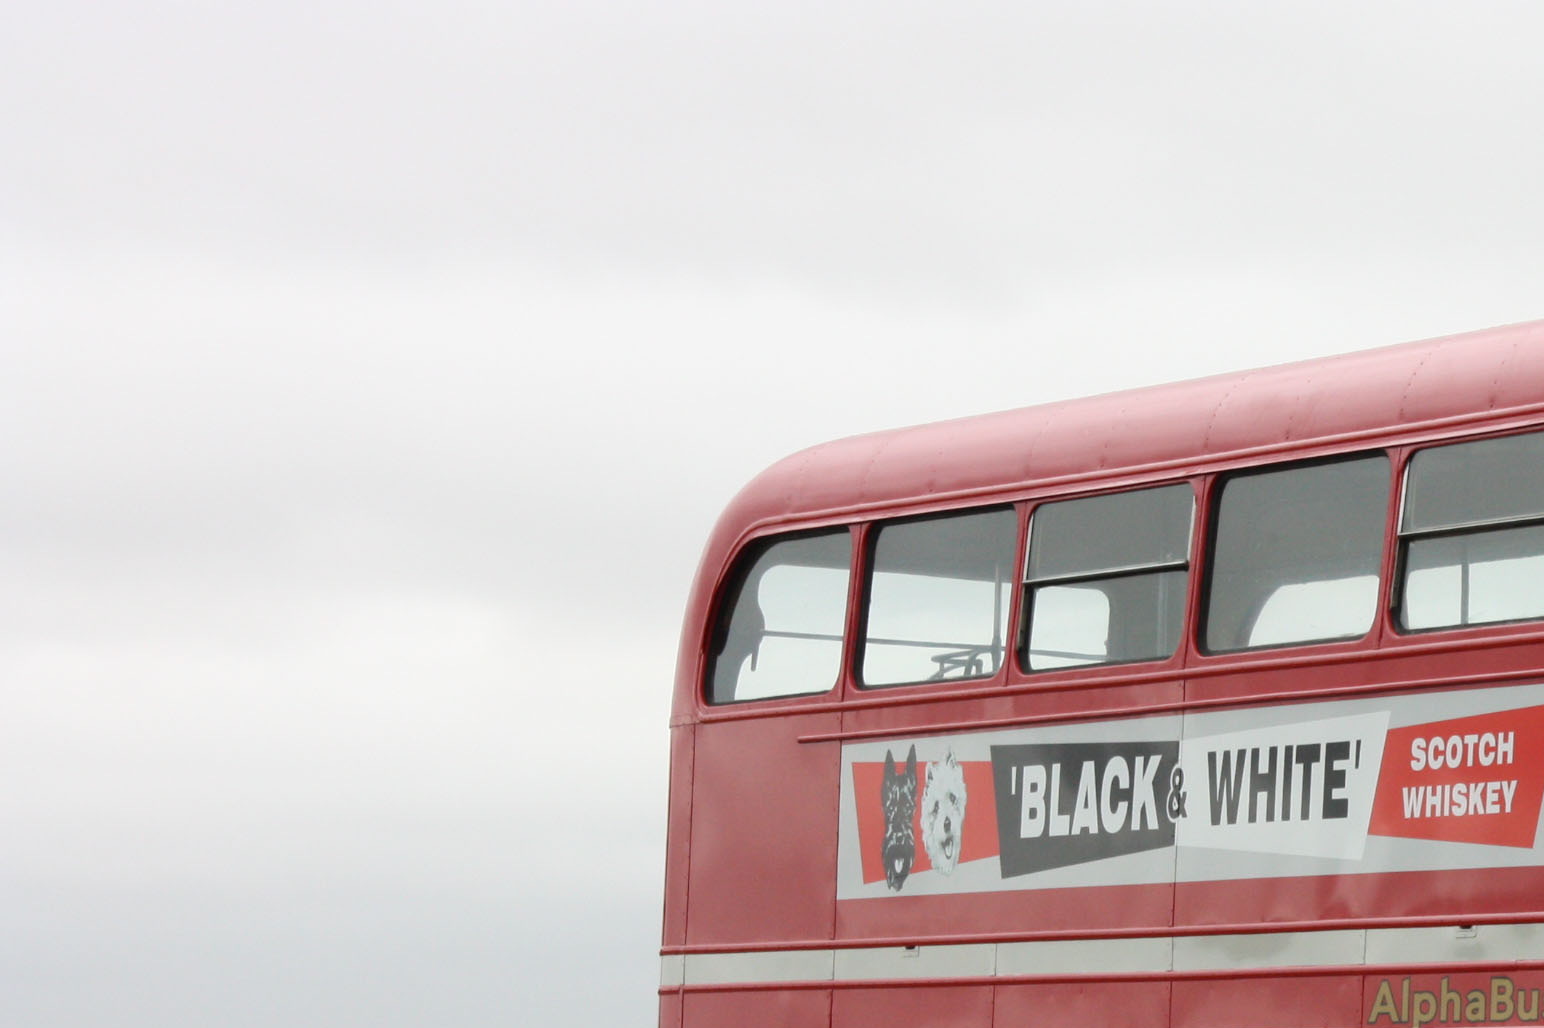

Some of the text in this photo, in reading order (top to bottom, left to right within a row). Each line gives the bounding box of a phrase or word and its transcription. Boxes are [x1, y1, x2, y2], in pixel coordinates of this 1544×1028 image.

[1410, 731, 1514, 772] SCOTCH
[1166, 762, 1188, 824] &
[1402, 779, 1518, 819] WHISKEY
